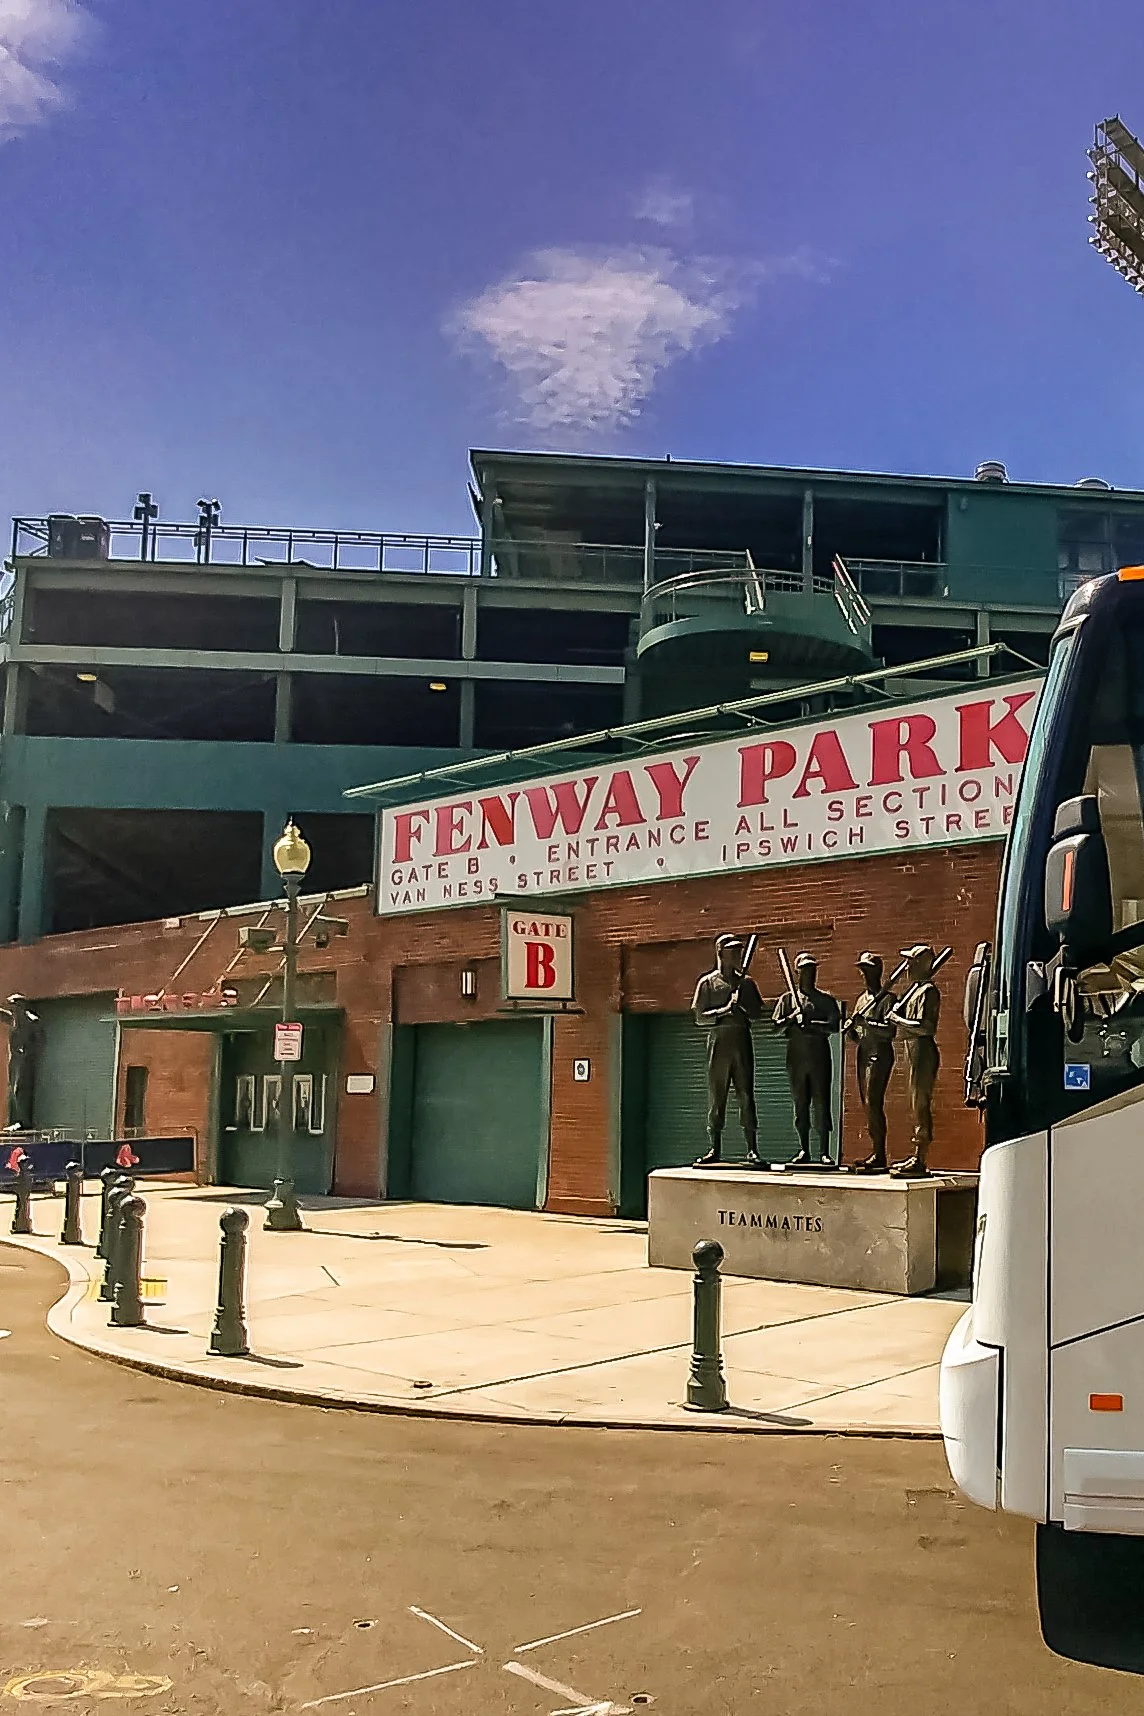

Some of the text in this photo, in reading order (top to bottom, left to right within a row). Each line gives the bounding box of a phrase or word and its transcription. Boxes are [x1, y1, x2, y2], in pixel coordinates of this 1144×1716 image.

[391, 691, 1036, 864] FENWAY PARK
[390, 861, 450, 886] GATE
[467, 857, 480, 875] B
[547, 821, 711, 863] ENTRANCE
[734, 808, 799, 835] ALL
[390, 887, 426, 906] VAN
[443, 878, 499, 898] NESS
[517, 860, 615, 890] STREET
[721, 825, 865, 862] IPSWICH
[512, 920, 567, 938] GATE
[523, 941, 556, 989] B
[717, 1210, 822, 1232] TEAMMATES
